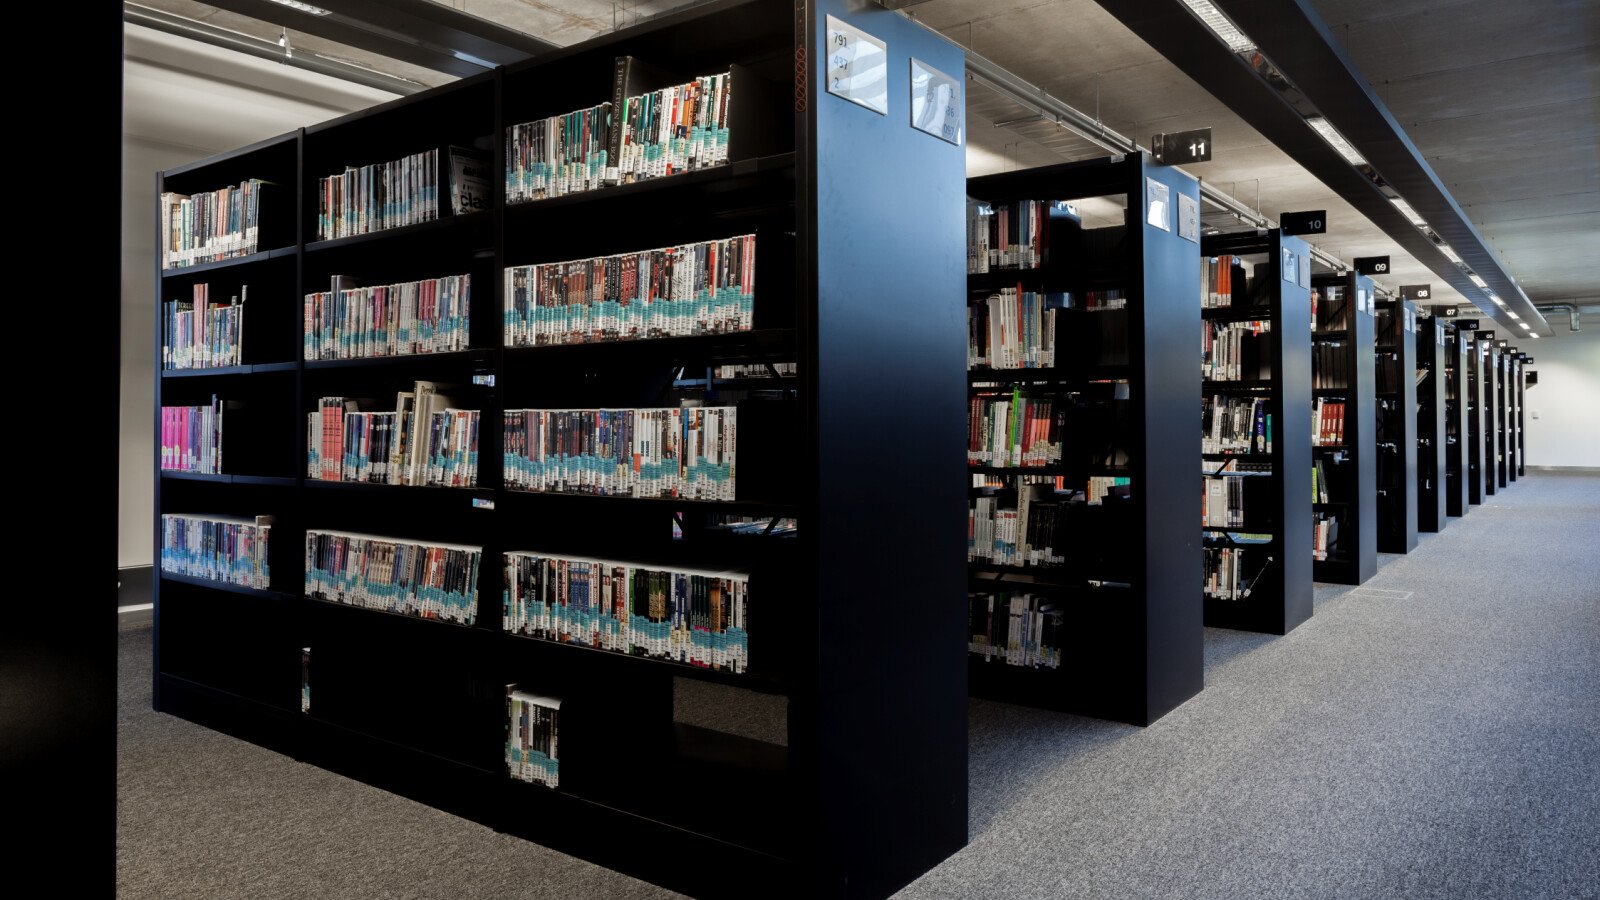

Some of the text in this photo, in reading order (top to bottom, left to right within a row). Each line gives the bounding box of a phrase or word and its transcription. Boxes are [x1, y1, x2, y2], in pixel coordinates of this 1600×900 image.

[834, 55, 848, 71] 437
[616, 68, 624, 85] THE
[834, 76, 840, 89] 2
[613, 87, 622, 120] CITIZEN
[611, 122, 620, 144] KANE
[1189, 142, 1205, 157] 11
[1308, 219, 1322, 230] 10
[1375, 263, 1387, 272] 09
[1417, 290, 1428, 298] 08
